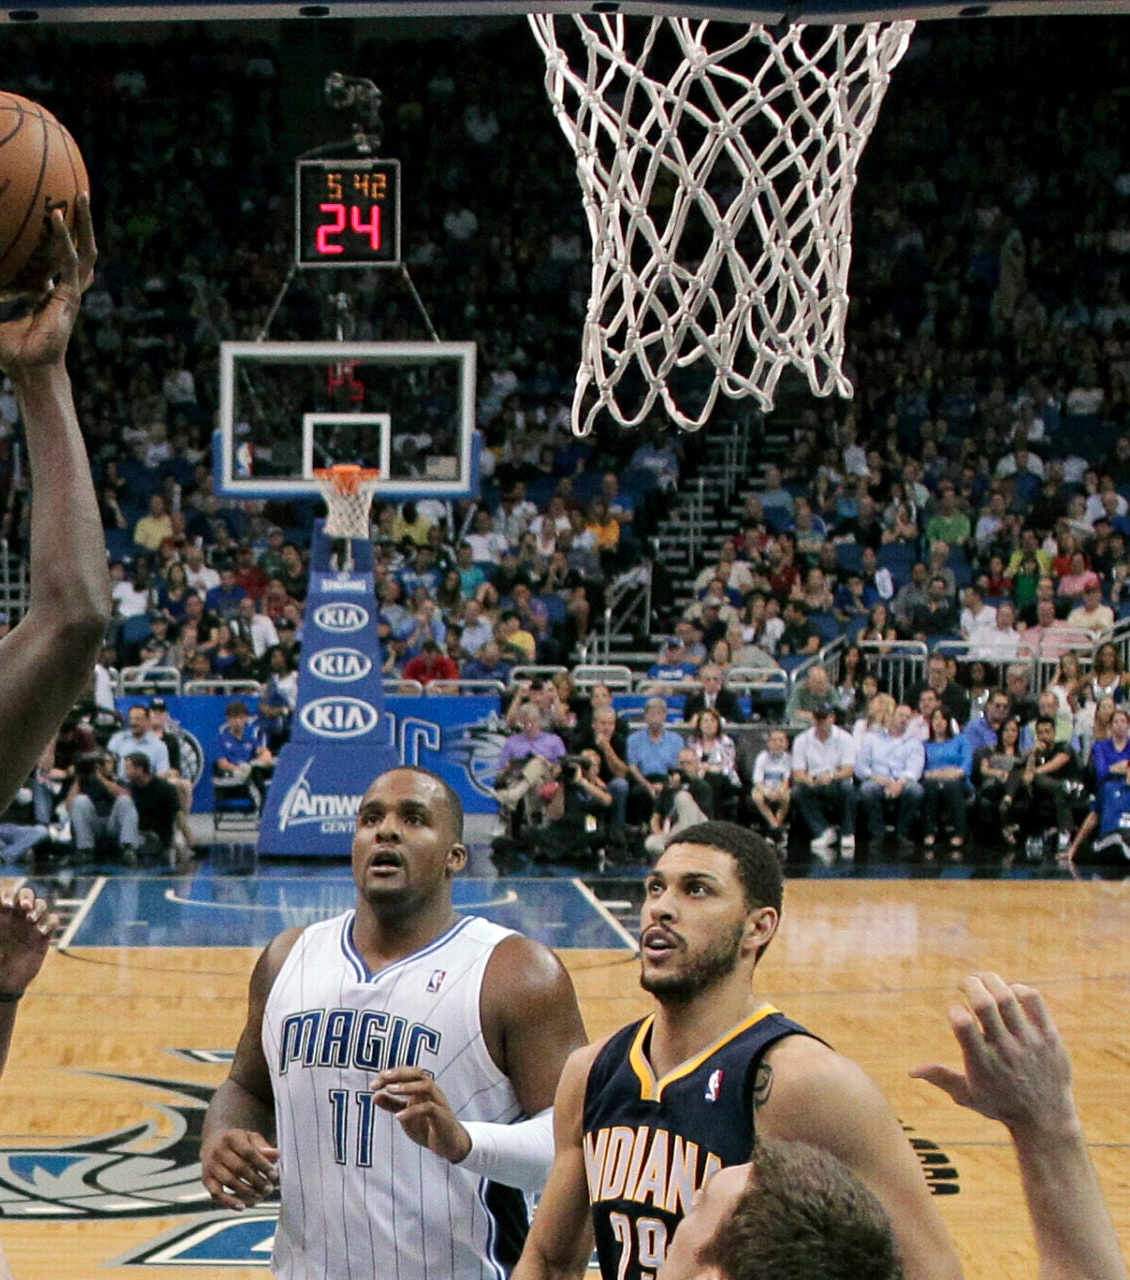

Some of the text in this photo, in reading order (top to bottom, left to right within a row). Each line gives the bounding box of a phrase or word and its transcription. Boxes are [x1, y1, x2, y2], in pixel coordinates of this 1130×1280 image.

[316, 203, 382, 255] 24
[323, 608, 361, 627] KIA
[319, 655, 363, 675] KIA
[313, 704, 366, 729] KIA
[291, 788, 363, 816] Amw
[320, 821, 357, 834] CENT
[328, 1088, 376, 1168] 11
[582, 1125, 723, 1218] NDIAN
